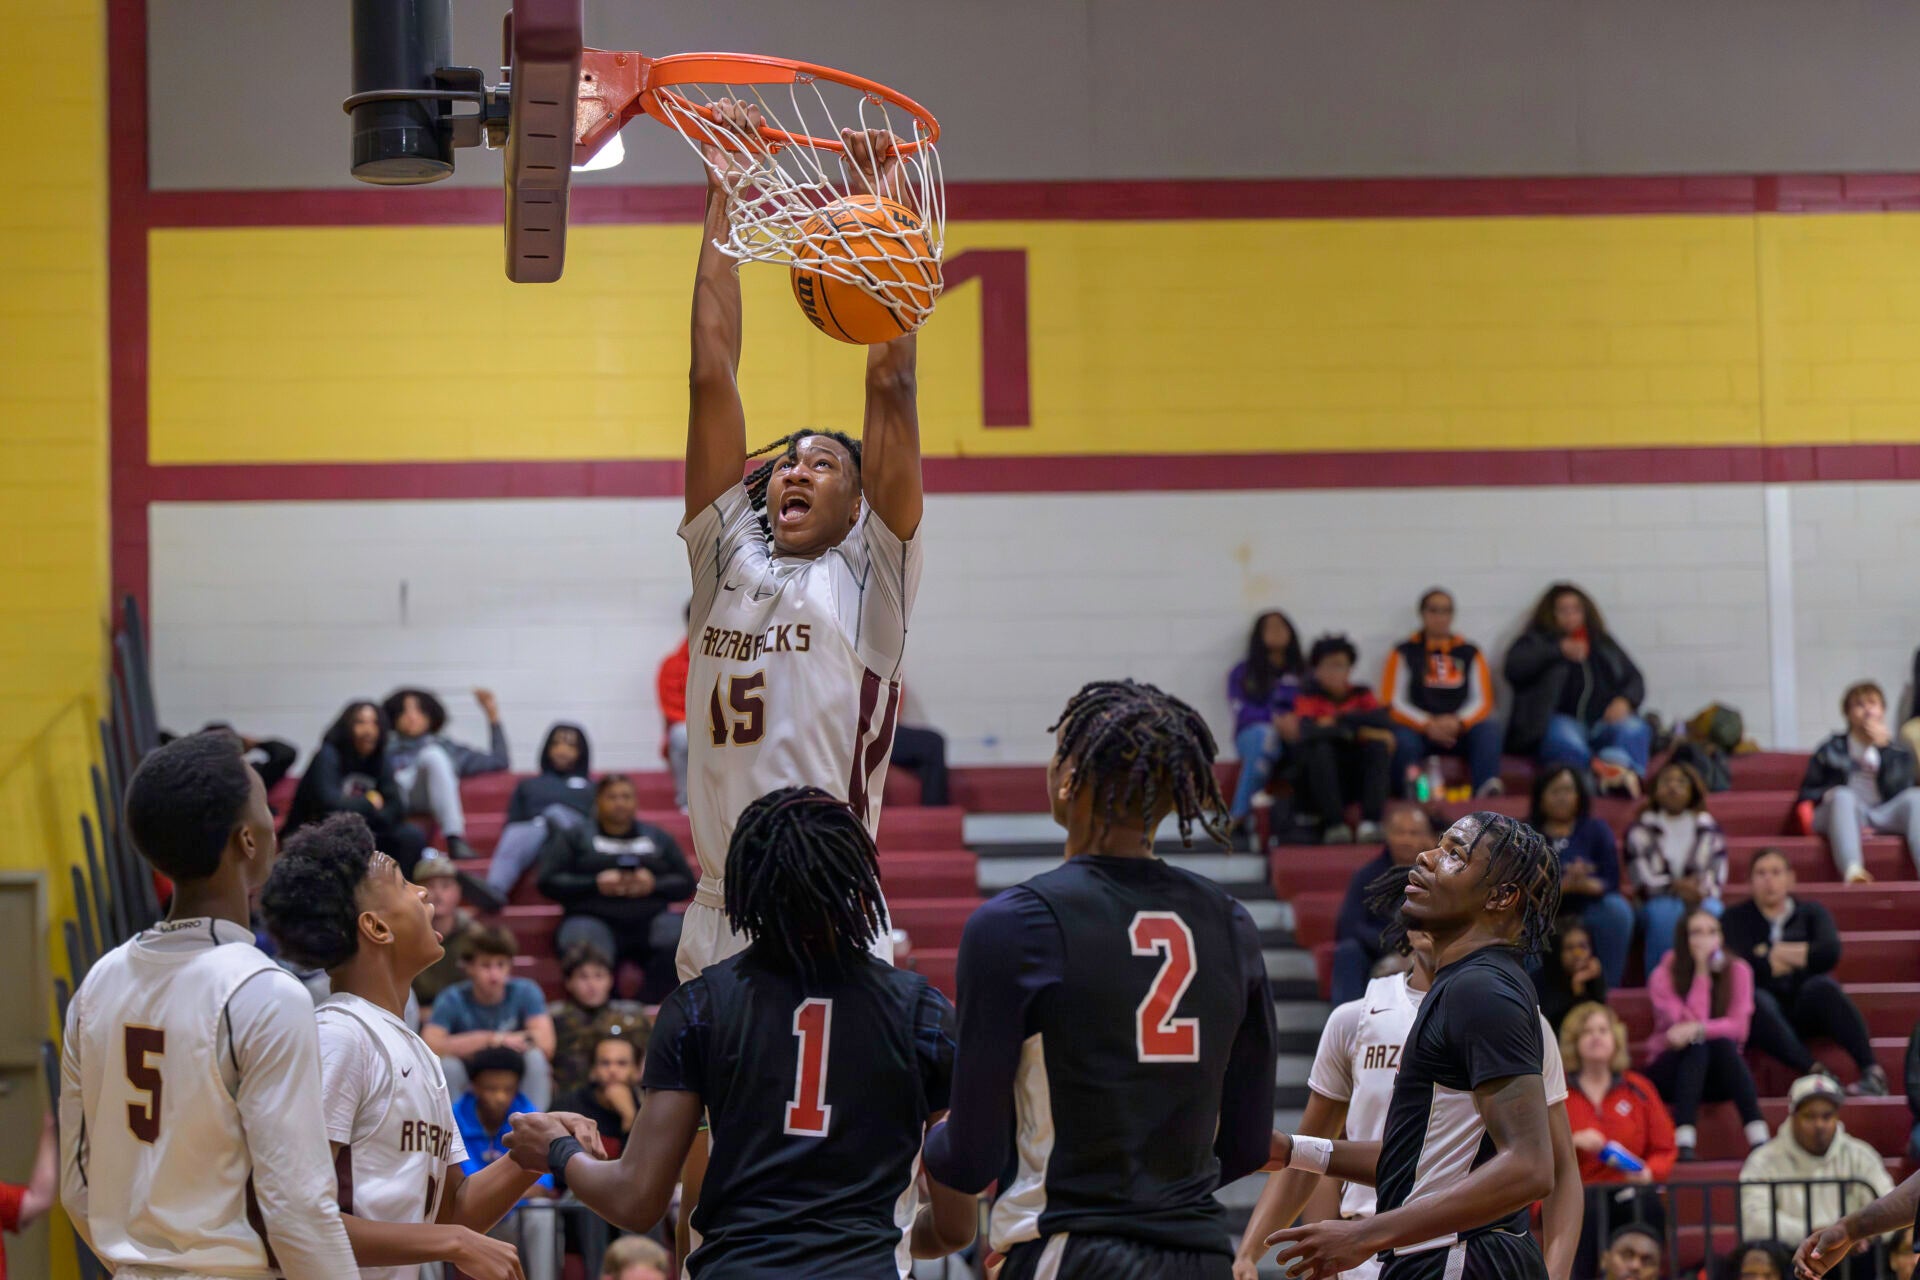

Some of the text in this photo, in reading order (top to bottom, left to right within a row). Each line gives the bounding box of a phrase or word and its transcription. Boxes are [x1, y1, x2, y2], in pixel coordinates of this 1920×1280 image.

[708, 668, 767, 748] 15
[1128, 911, 1200, 1063] 2
[123, 1022, 166, 1146] 5
[783, 997, 833, 1138] 1
[1363, 1044, 1401, 1070] RAZ
